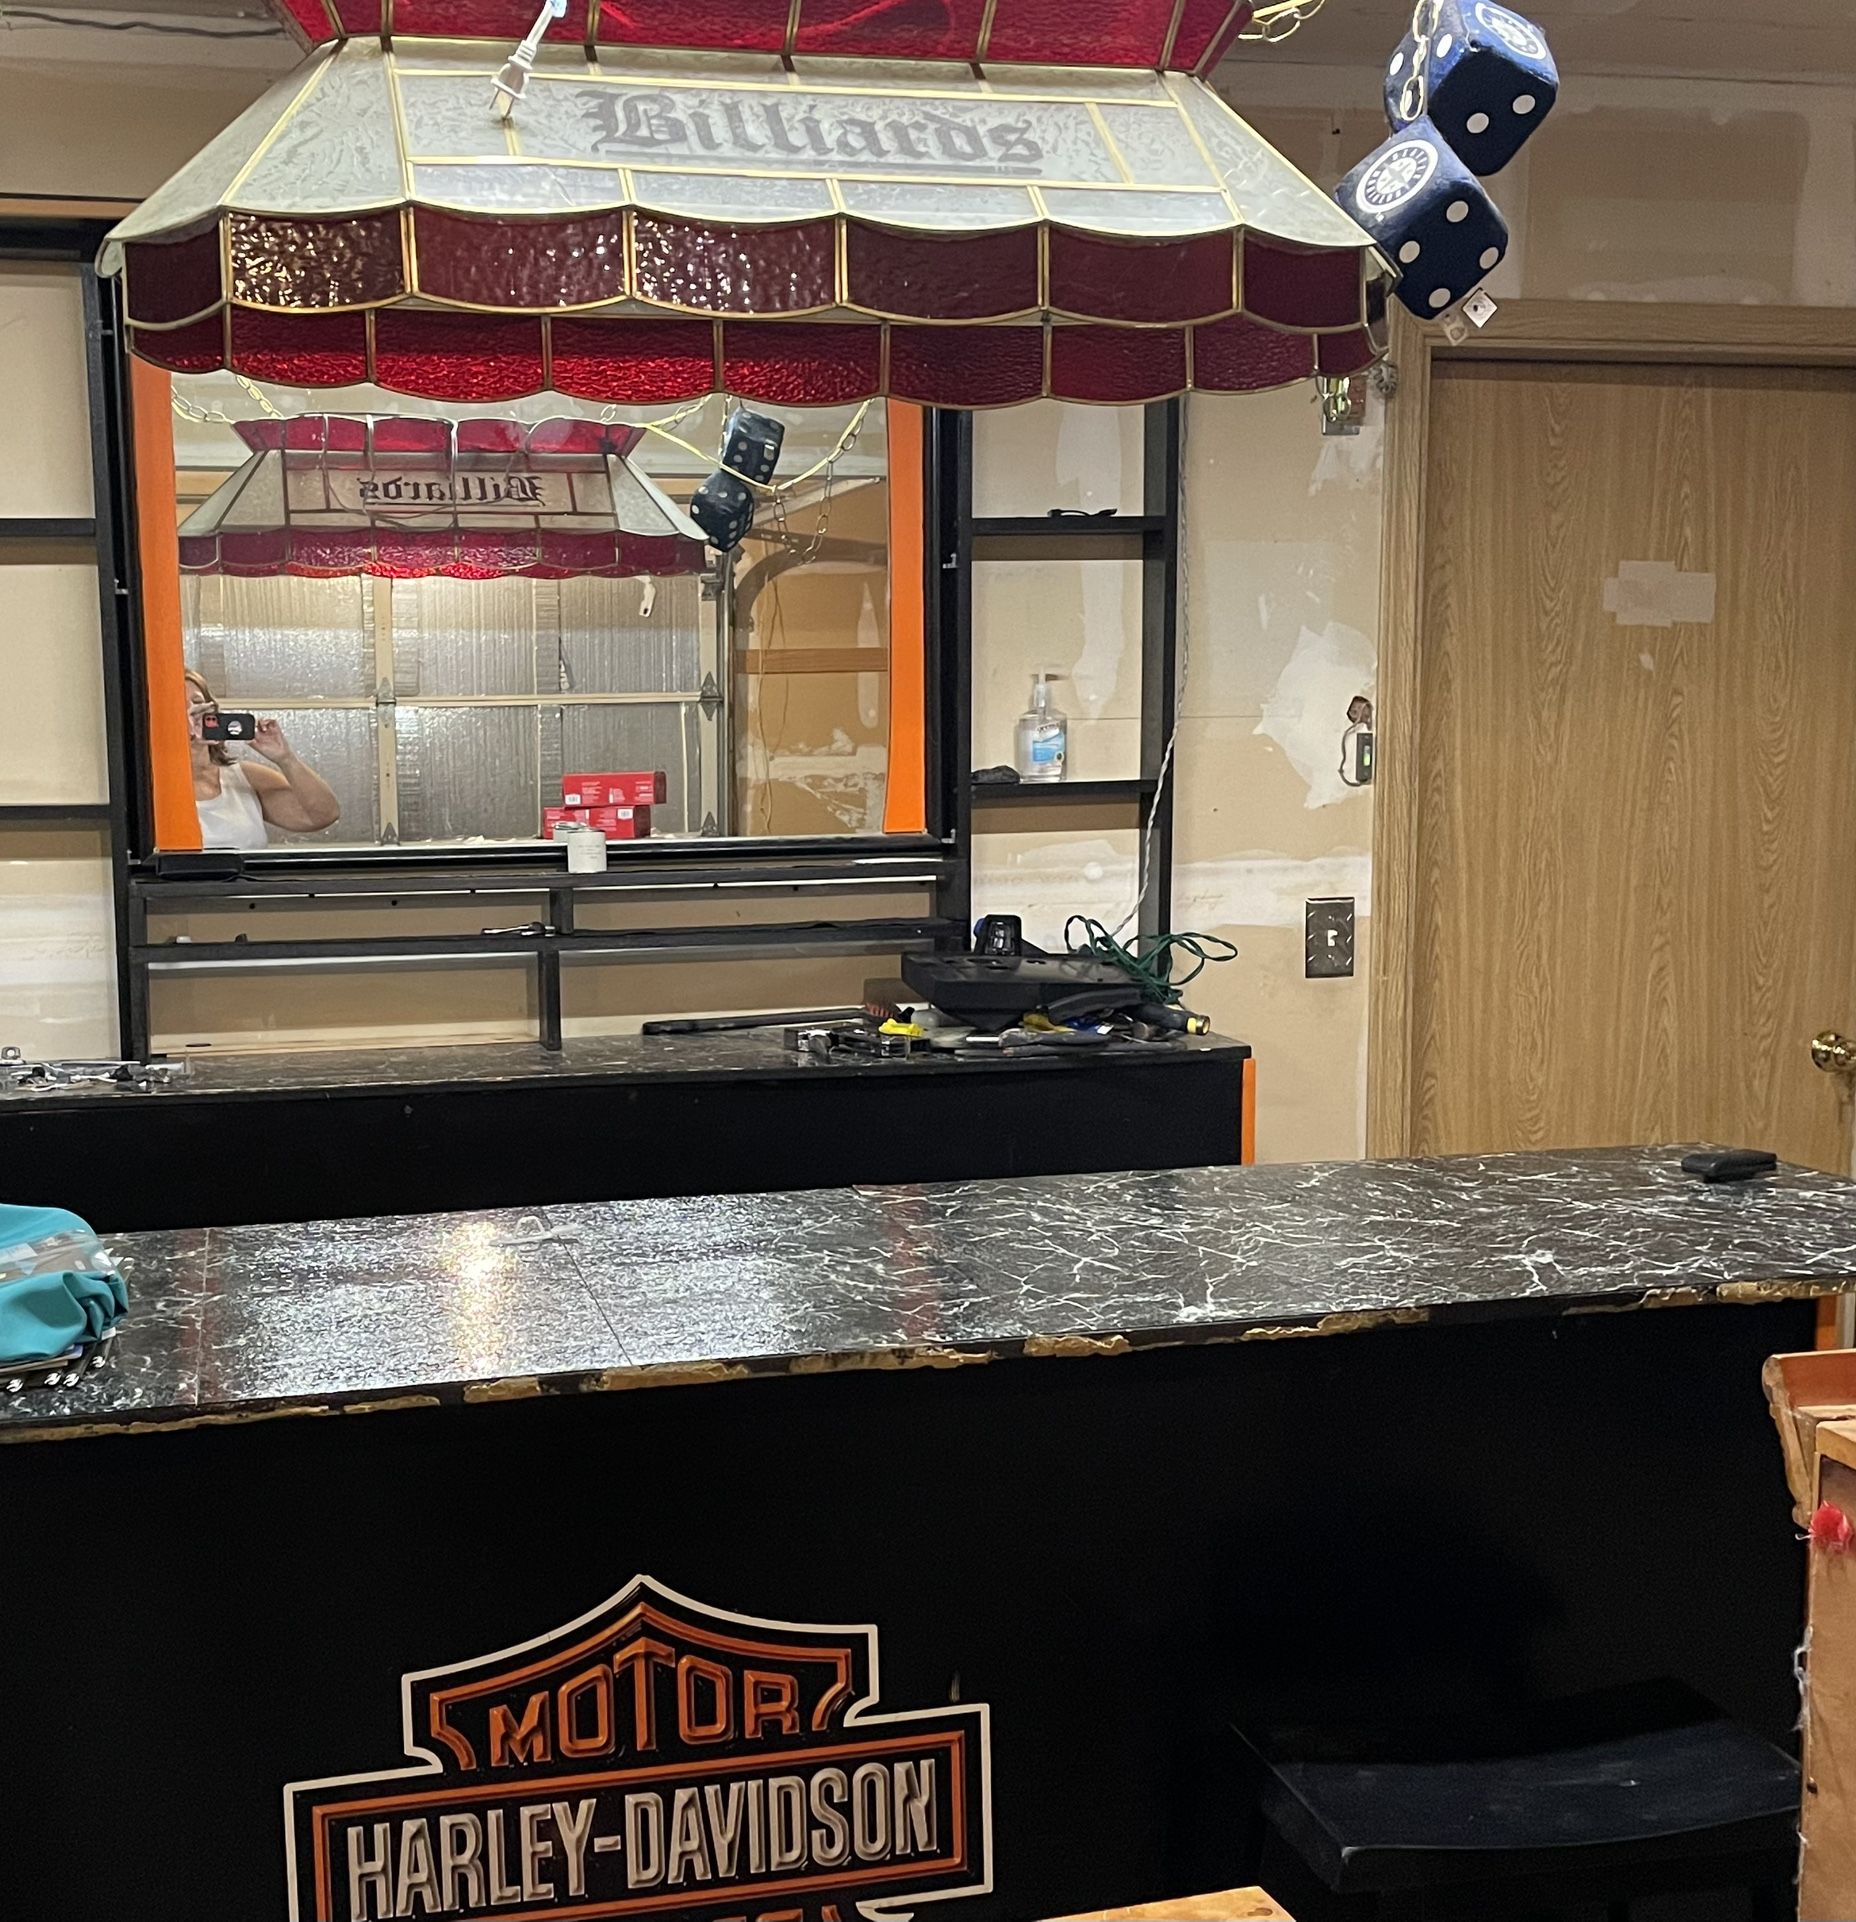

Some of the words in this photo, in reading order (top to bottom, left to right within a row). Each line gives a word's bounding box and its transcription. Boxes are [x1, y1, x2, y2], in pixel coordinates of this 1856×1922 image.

[574, 89, 1042, 163] Billiards
[490, 1638, 801, 1768] MOTOR
[346, 1758, 940, 1922] HARLEY-DAVIDSON
